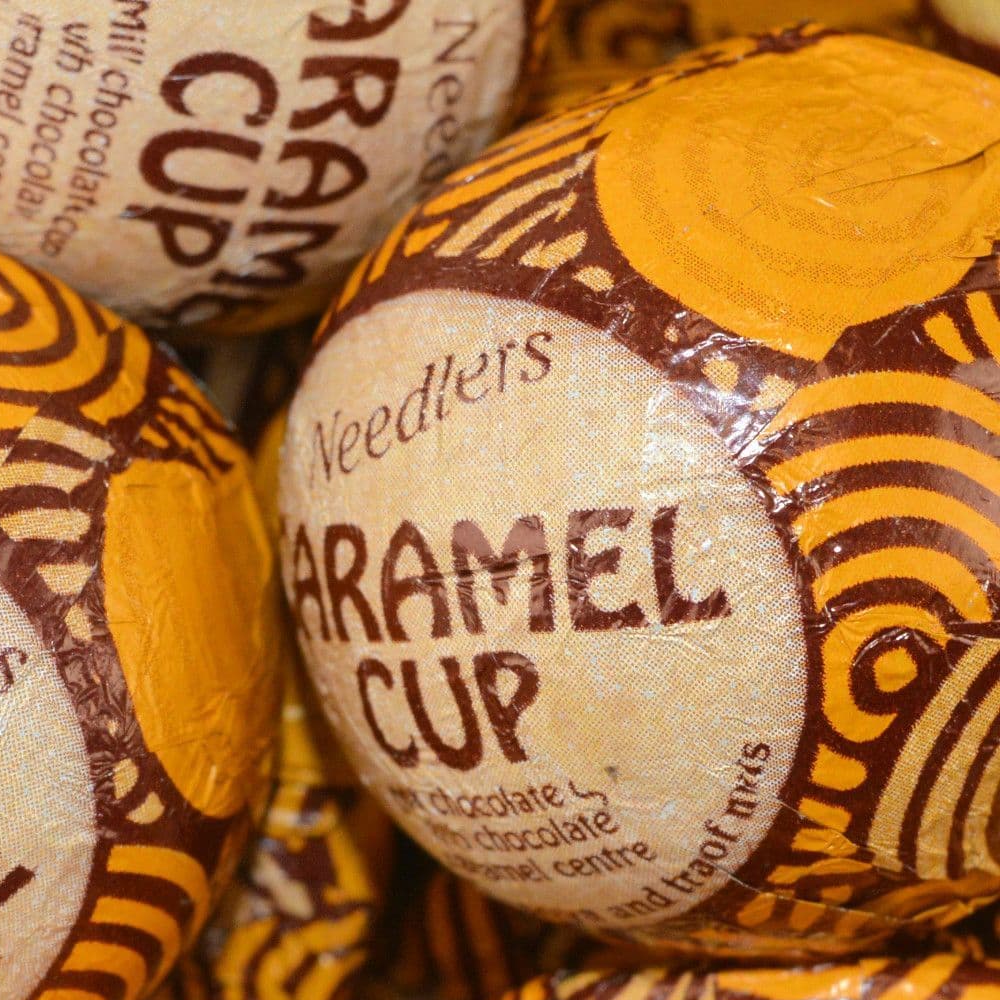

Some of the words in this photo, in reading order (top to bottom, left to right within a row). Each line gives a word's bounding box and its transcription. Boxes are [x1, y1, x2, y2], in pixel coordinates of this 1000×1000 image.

[125, 52, 278, 267] CUP
[310, 328, 555, 487] Needlers
[282, 504, 733, 645] ARAMEL
[355, 650, 541, 771] CUP
[473, 806, 621, 853] chocolate
[551, 840, 658, 879] centre
